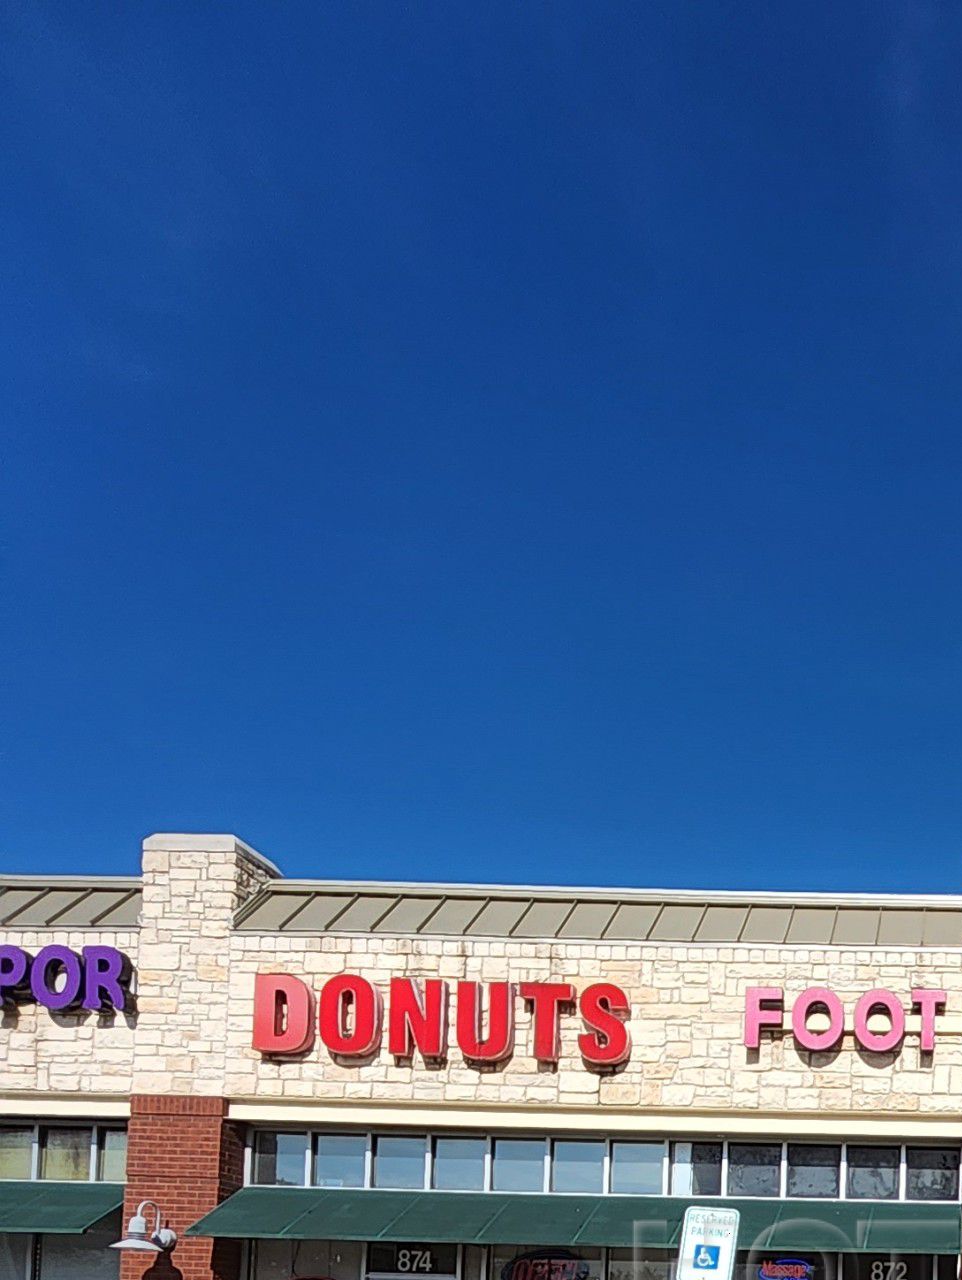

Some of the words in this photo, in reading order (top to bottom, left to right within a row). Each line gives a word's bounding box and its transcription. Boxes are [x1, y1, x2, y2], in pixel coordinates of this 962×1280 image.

[252, 973, 631, 1064] DONUTS
[744, 986, 947, 1051] FOOT
[689, 1212, 734, 1226] RESERVED
[691, 1226, 730, 1239] PARKING
[397, 1250, 432, 1272] 874
[762, 1259, 807, 1279] Massage
